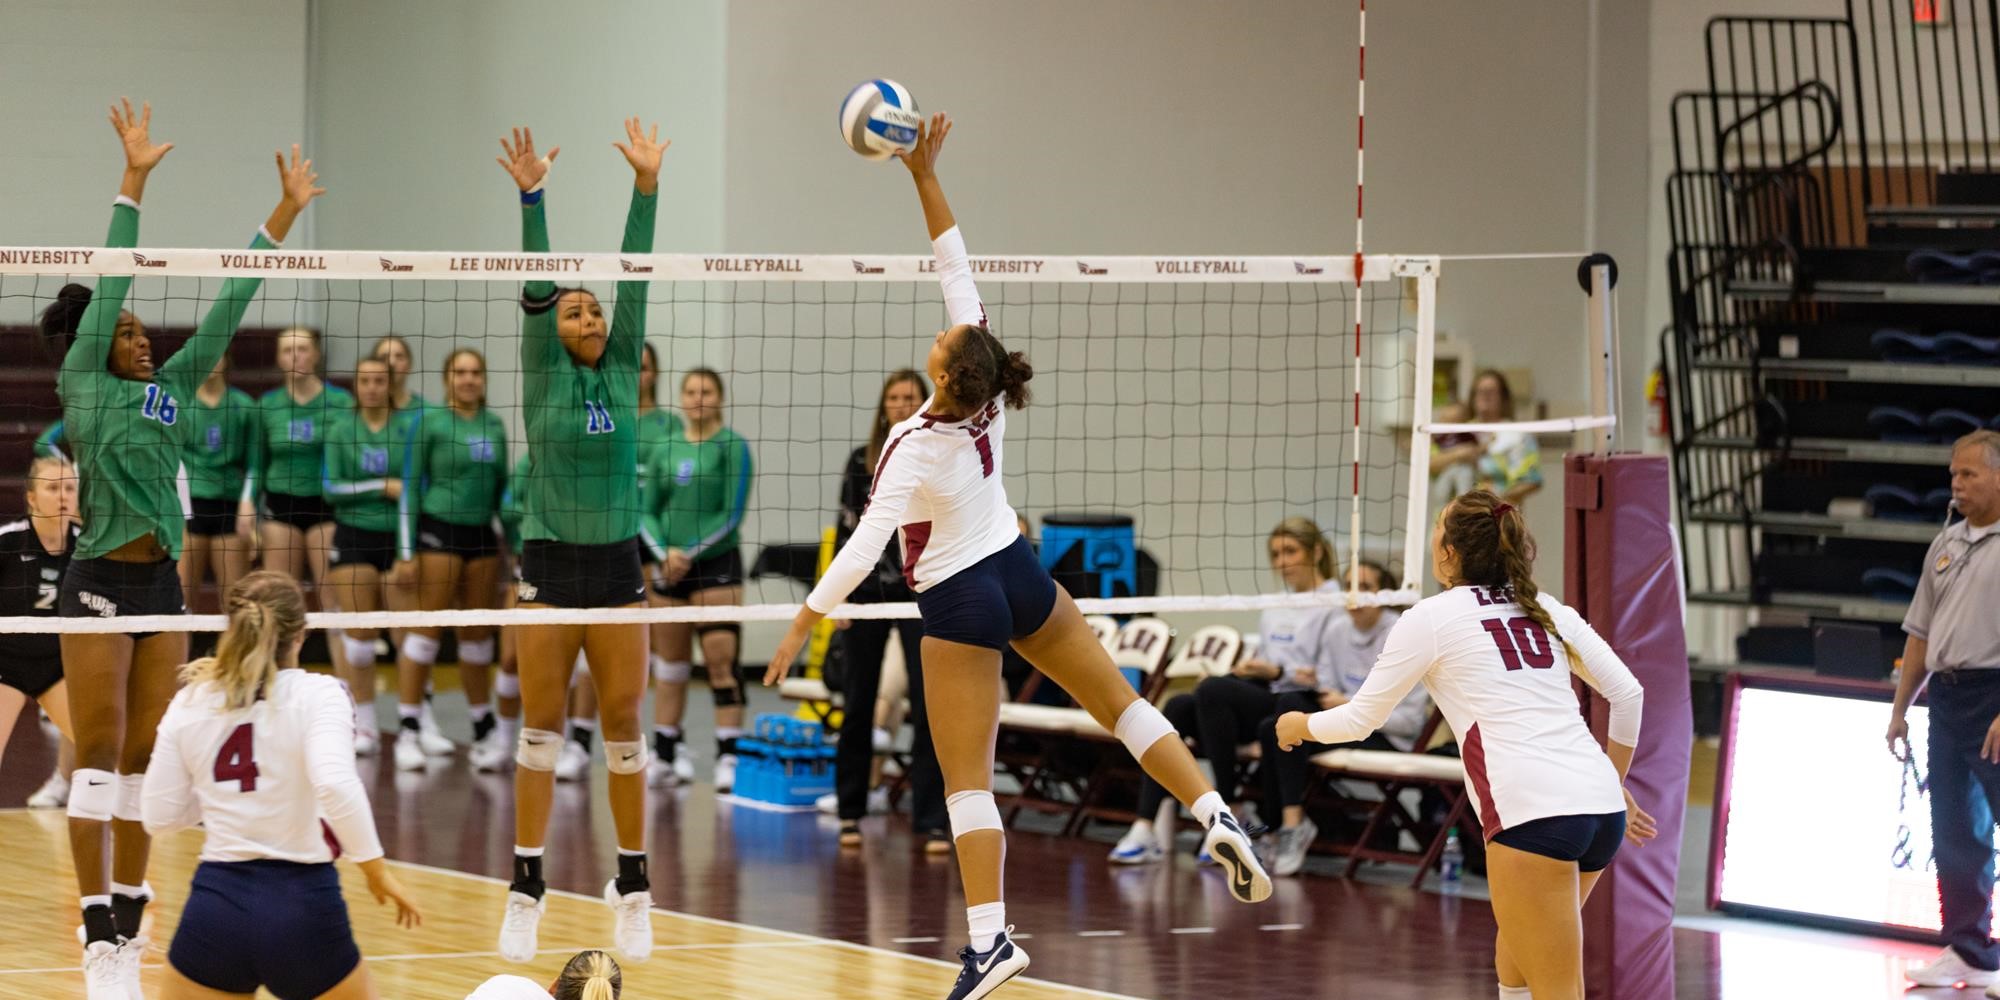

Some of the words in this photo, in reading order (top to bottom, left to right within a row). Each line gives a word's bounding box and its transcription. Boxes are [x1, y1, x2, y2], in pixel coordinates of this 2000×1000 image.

[0, 250, 94, 265] NIVERSITY
[220, 254, 328, 270] VOLLEYBALL
[449, 257, 480, 272] LEE
[484, 257, 585, 272] UNIVERSITY
[703, 258, 804, 273] VOLLEYBALL
[918, 259, 937, 273] LE
[968, 260, 1044, 273] IVERSITY
[1155, 260, 1248, 274] VOLLEYBALL
[141, 383, 178, 427] 16
[585, 399, 616, 435] 11
[974, 432, 994, 479] 1
[34, 583, 58, 610] 2
[1480, 616, 1555, 671] 10
[213, 722, 260, 793] 4
